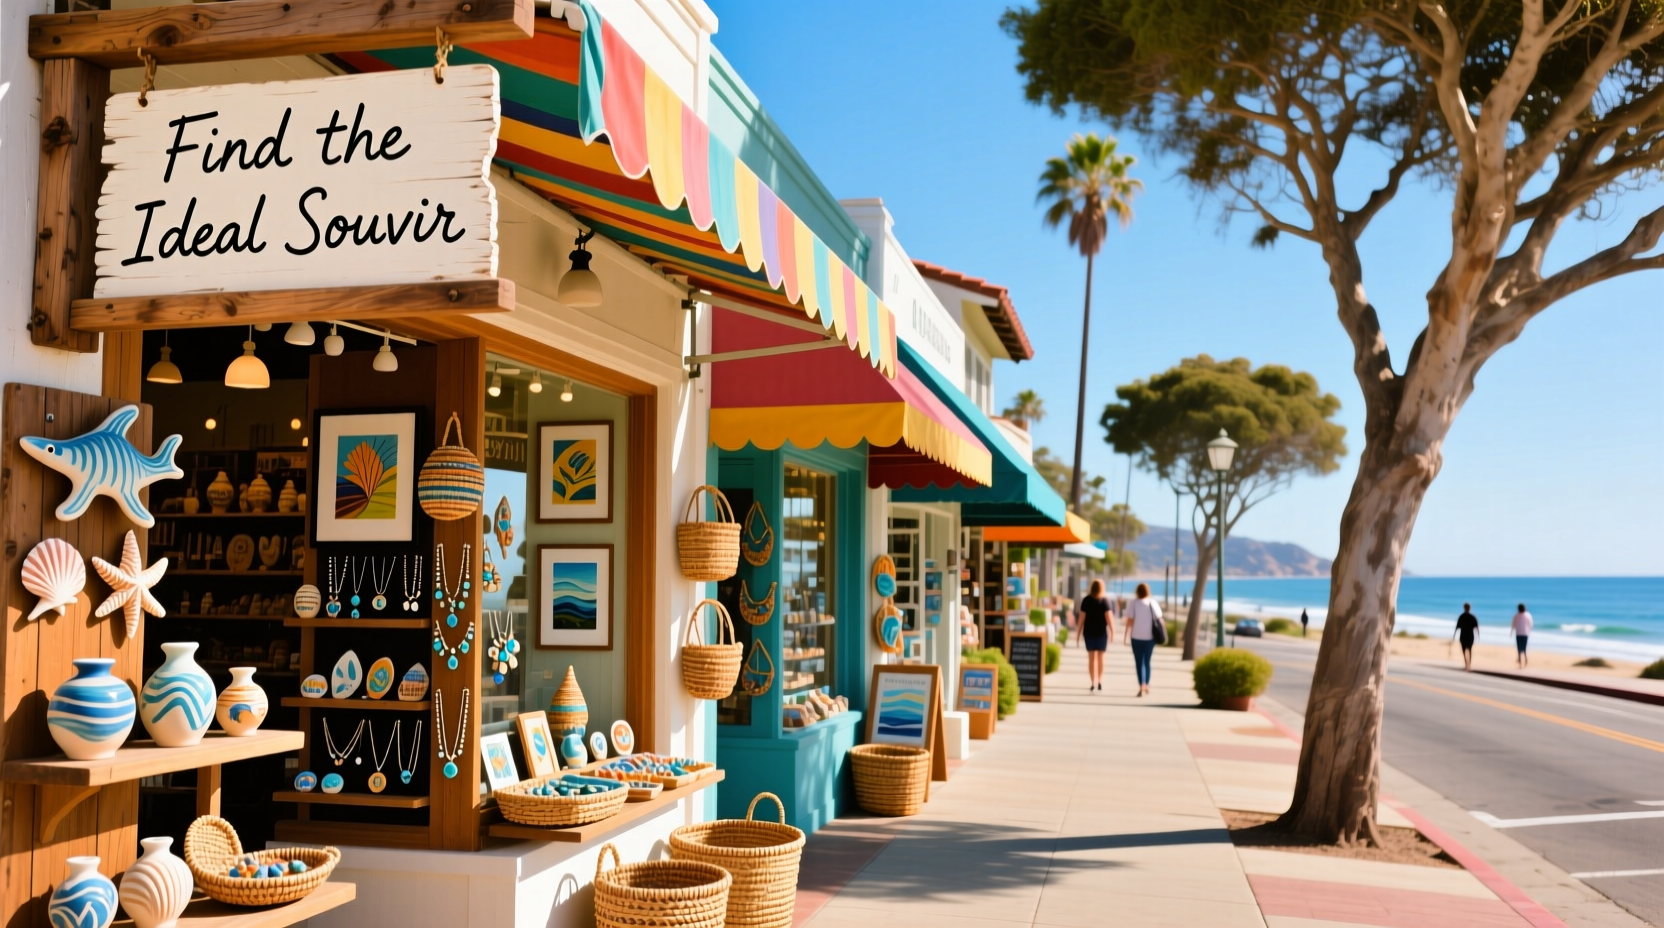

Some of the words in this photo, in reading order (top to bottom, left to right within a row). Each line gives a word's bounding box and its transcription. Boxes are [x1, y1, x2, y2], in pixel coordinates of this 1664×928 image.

[163, 107, 293, 183] Find
[315, 102, 412, 166] the
[120, 193, 267, 267] Ideal
[284, 186, 466, 256] Souvir
